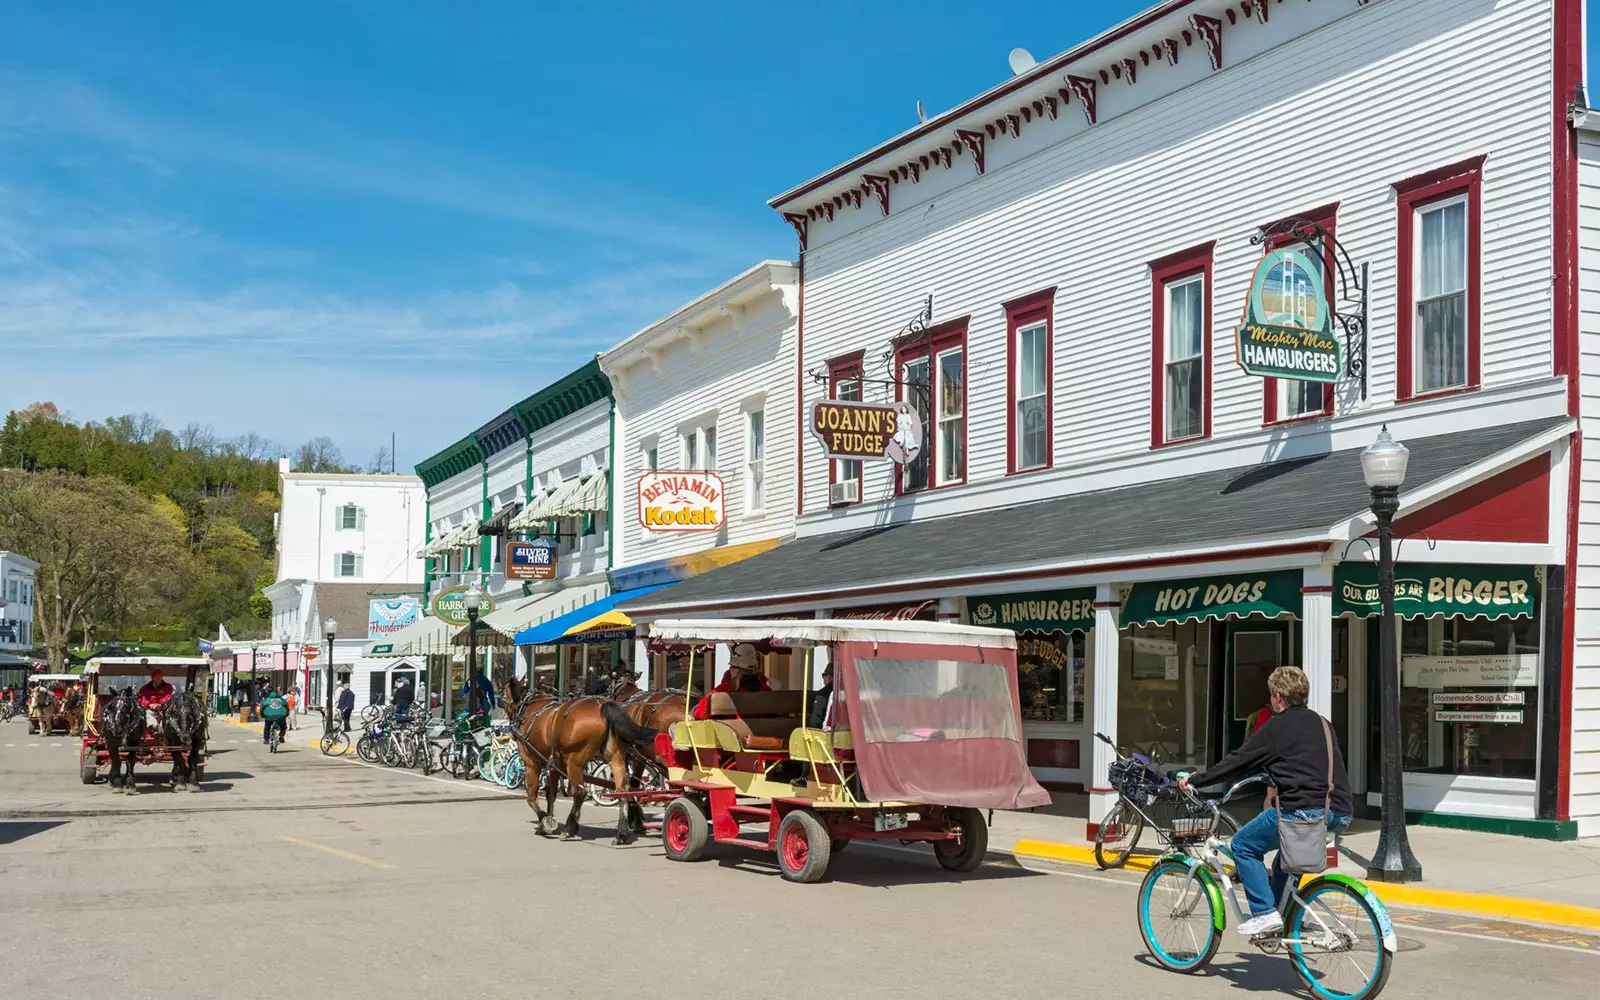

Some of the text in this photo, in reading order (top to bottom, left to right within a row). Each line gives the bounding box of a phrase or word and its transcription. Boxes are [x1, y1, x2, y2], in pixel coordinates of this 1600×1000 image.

[1247, 325, 1334, 349] Mighty Mac
[1244, 344, 1337, 373] HAMBURGERS
[817, 407, 895, 434] JOANN'S
[832, 432, 884, 453] FUDGE
[642, 476, 720, 503] BENJAMIN
[645, 506, 718, 525] Kodak
[516, 547, 549, 556] SILVER
[527, 554, 549, 564] MINE
[1155, 580, 1267, 612] HOT DOGS
[1343, 577, 1529, 605] OUR BURS ARE BIGGER
[972, 610, 997, 625] Pound
[1031, 639, 1068, 670] FUDGE
[1434, 694, 1520, 703] Homemade Soup & Chili
[1438, 712, 1460, 720] Burgers
[1463, 712, 1484, 720] served
